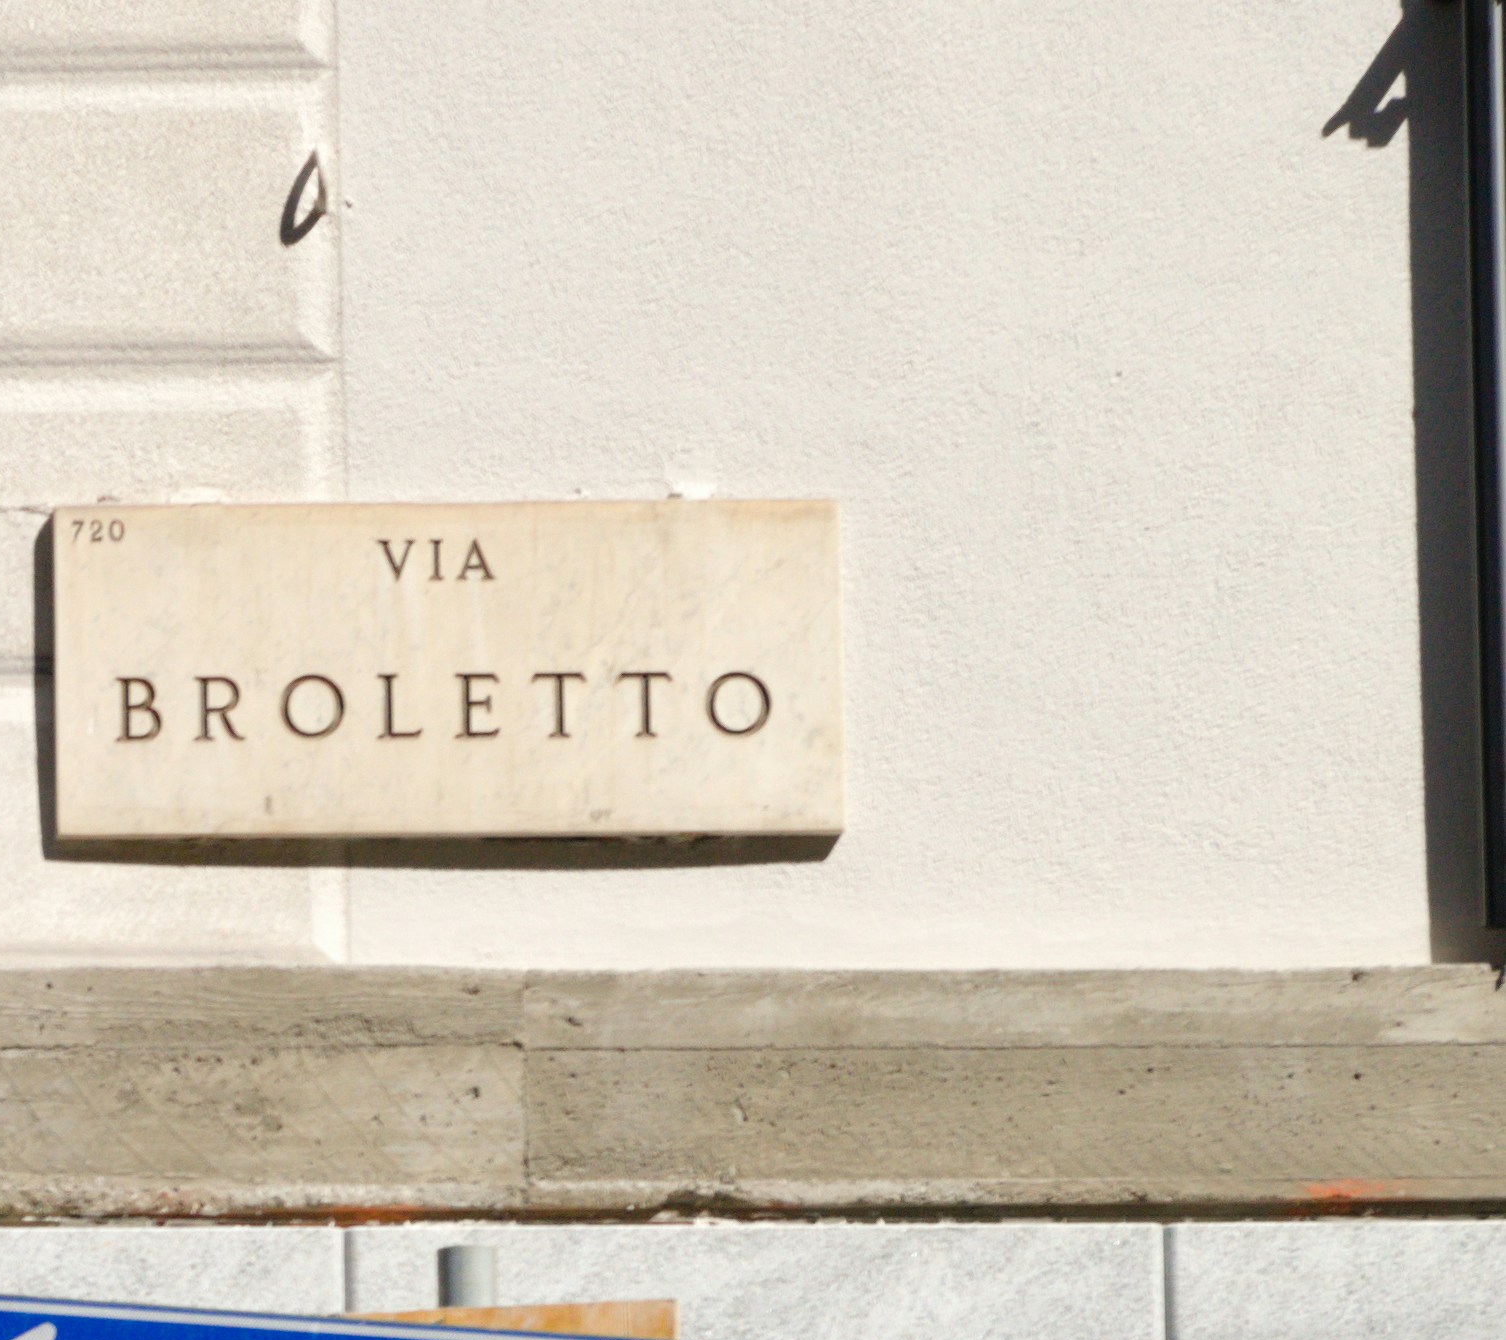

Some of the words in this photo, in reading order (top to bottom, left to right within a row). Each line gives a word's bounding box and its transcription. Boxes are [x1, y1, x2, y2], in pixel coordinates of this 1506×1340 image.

[70, 519, 127, 543] 720
[376, 538, 498, 582] VIA
[114, 670, 773, 744] BROLETTO
